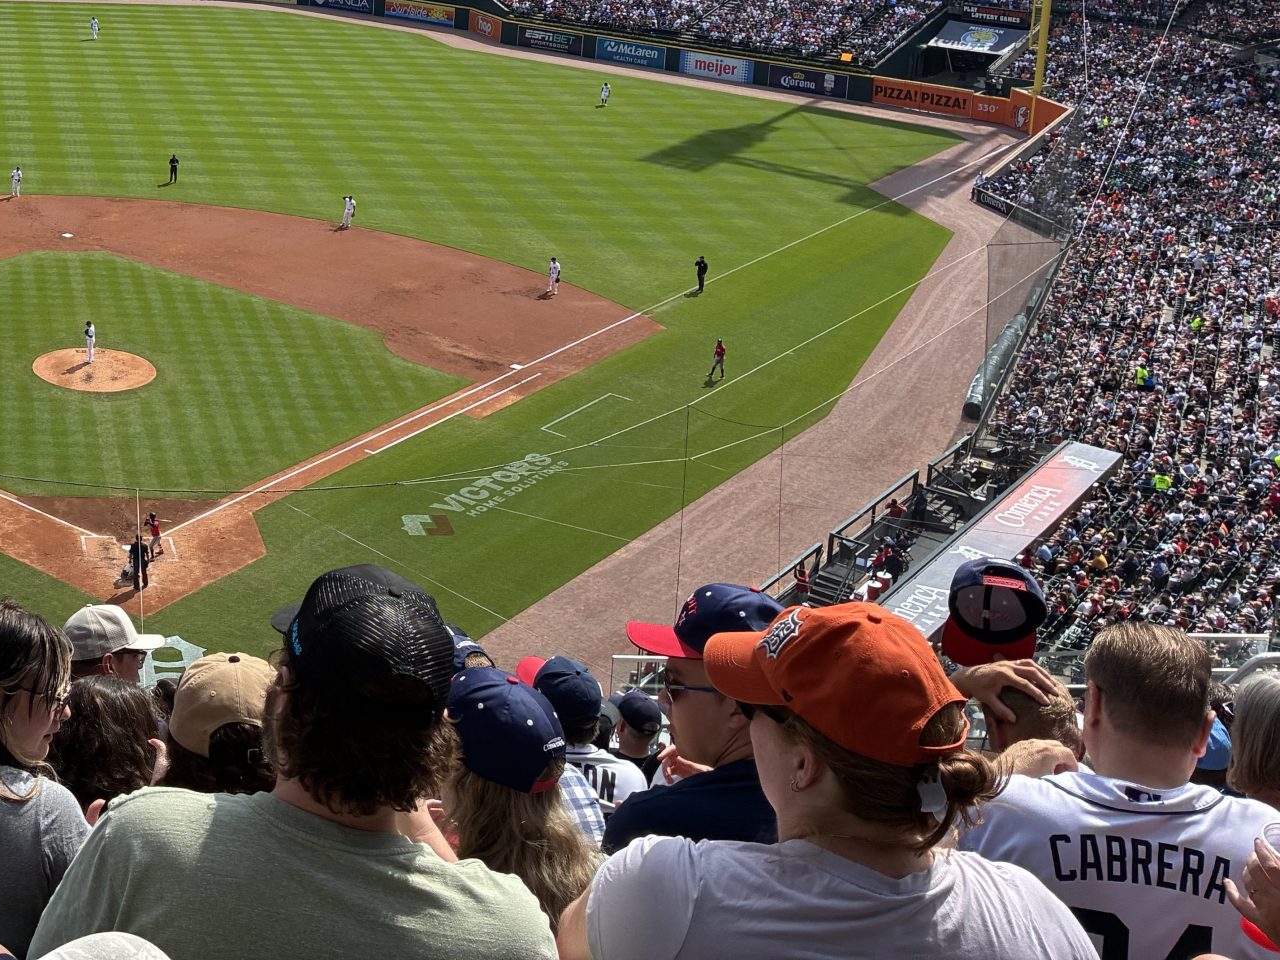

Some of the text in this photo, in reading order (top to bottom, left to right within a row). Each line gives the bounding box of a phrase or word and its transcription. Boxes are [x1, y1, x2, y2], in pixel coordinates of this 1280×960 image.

[390, 1, 428, 18] Surfside
[1000, 15, 1020, 23] GAMES
[968, 26, 1005, 34] MICHIGAN
[530, 40, 569, 50] SPORTSBOOK
[618, 44, 658, 59] McLaren
[613, 55, 633, 63] HEALTH
[694, 58, 737, 78] meijer
[780, 75, 816, 89] Corona
[874, 85, 967, 110] PIZZA! PIZZA!
[428, 453, 553, 513] VICTORS
[466, 460, 569, 518] HOME SOLUTIONS
[1034, 499, 1061, 523] PARK
[1049, 833, 1231, 905] CABRERA
